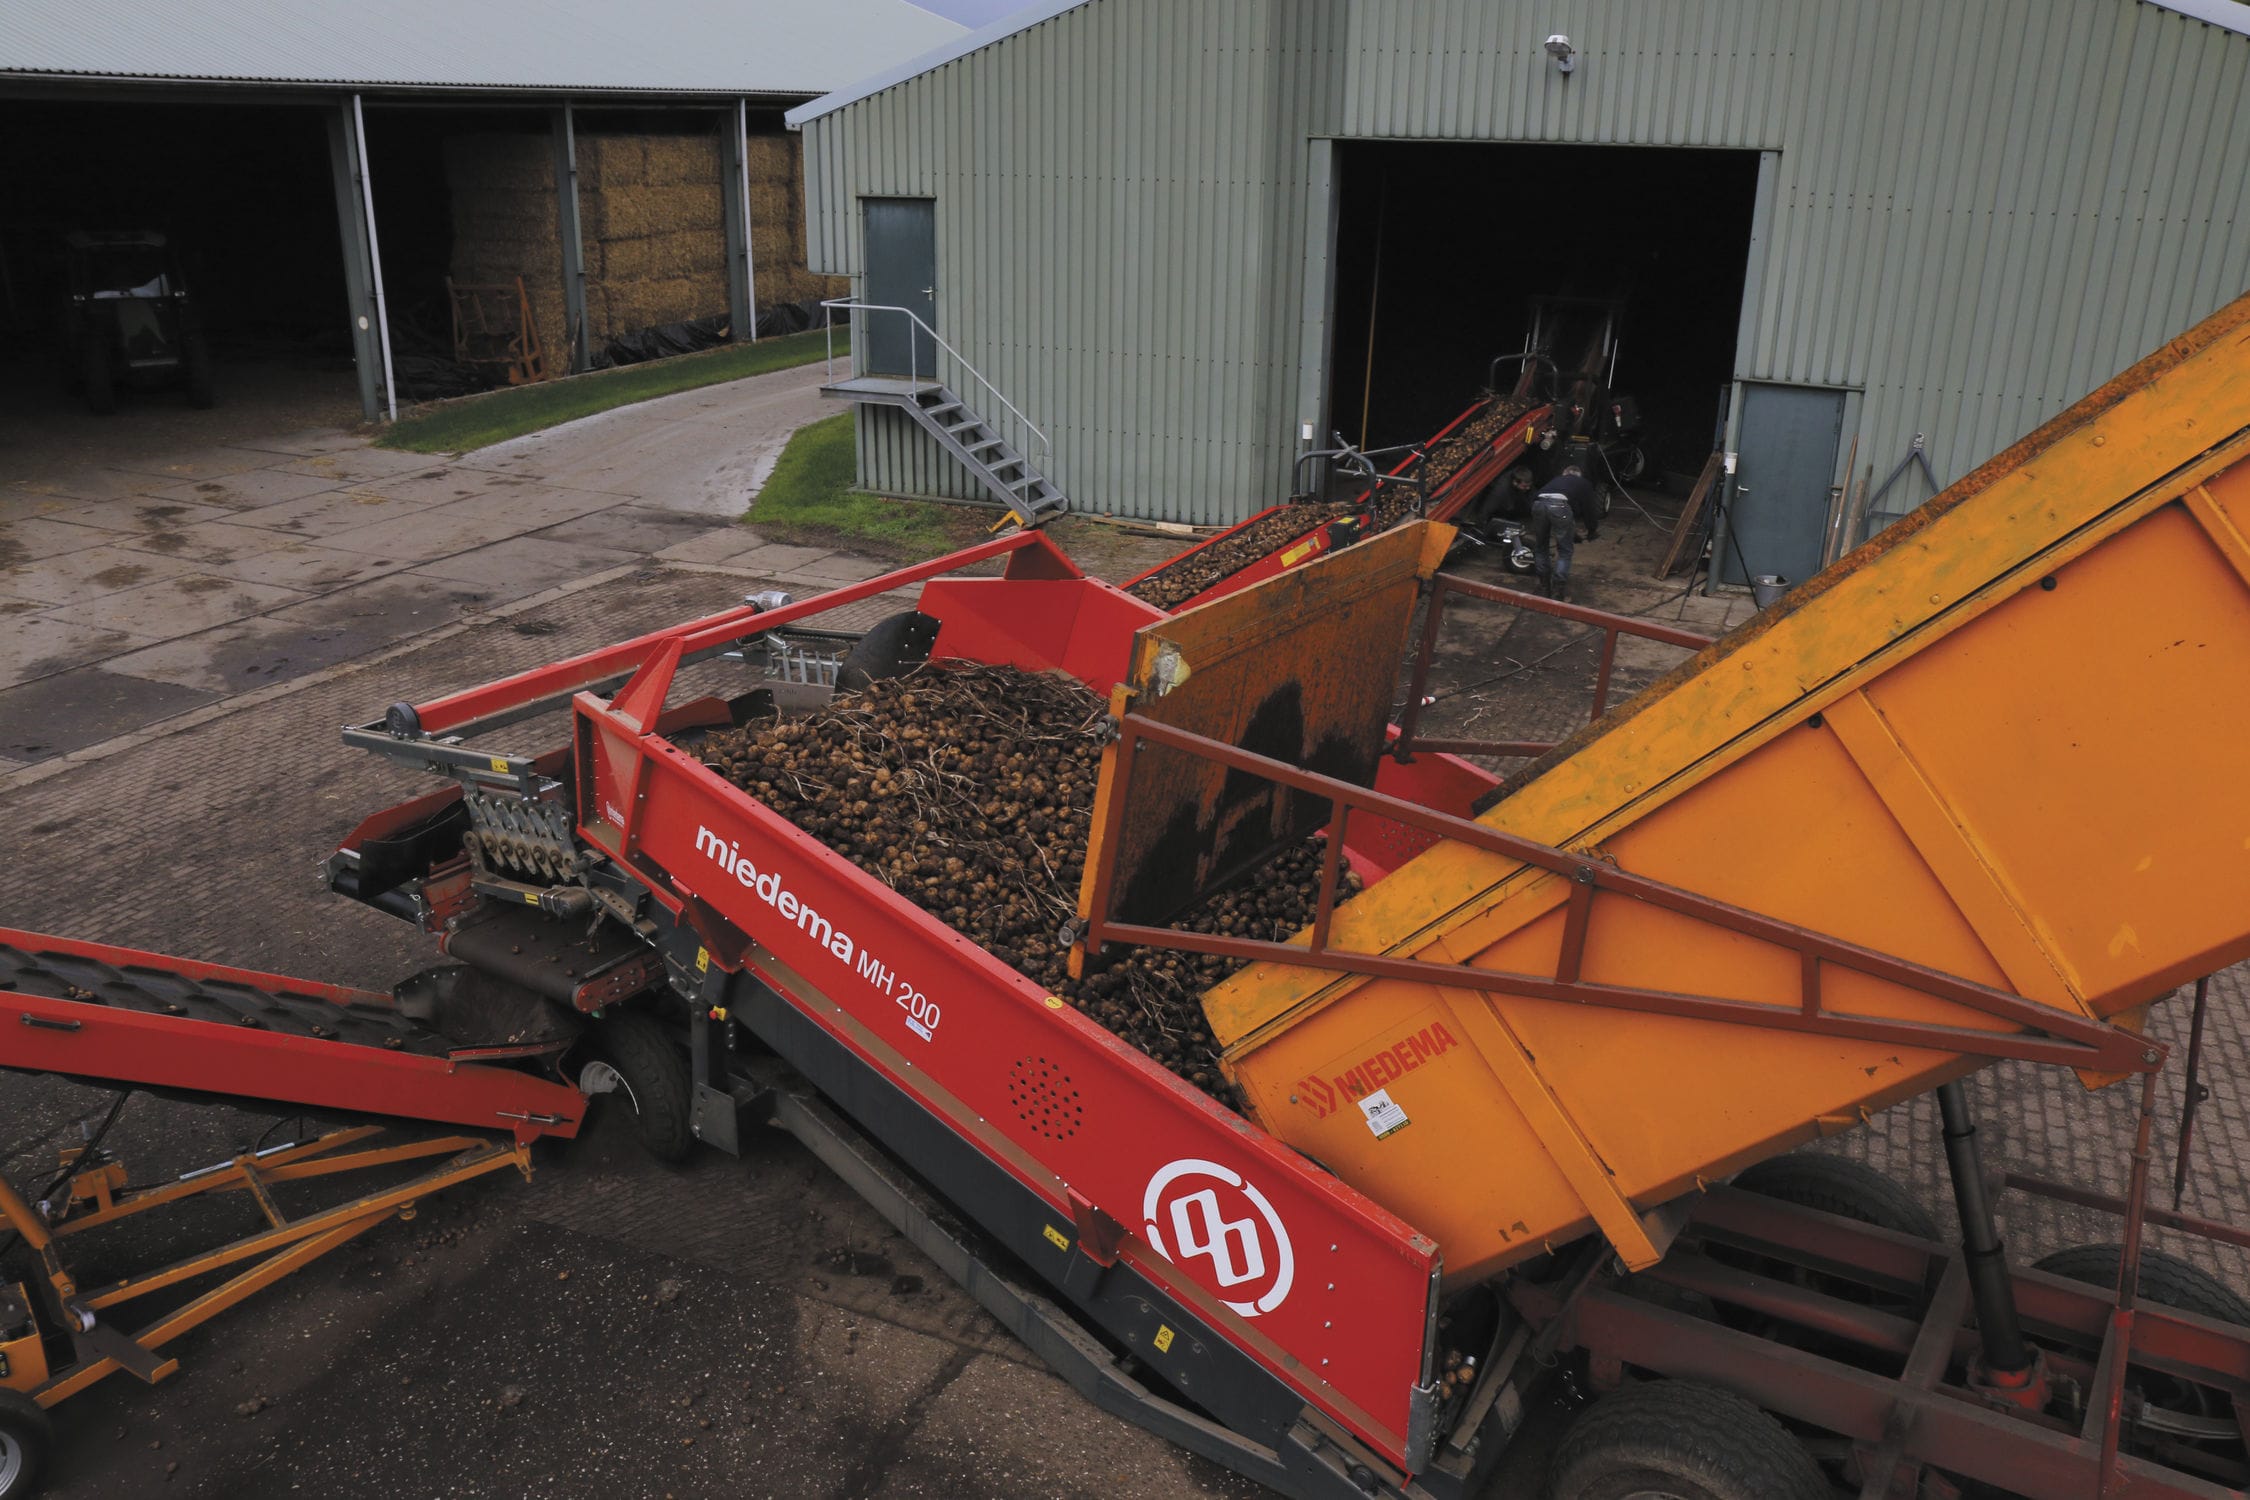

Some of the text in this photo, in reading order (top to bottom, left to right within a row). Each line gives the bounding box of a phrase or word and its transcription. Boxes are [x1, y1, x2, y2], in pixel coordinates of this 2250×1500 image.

[696, 825, 854, 965] miedema
[857, 950, 895, 996] MH
[896, 983, 940, 1029] 200
[1334, 1022, 1458, 1102] MIEDEMA
